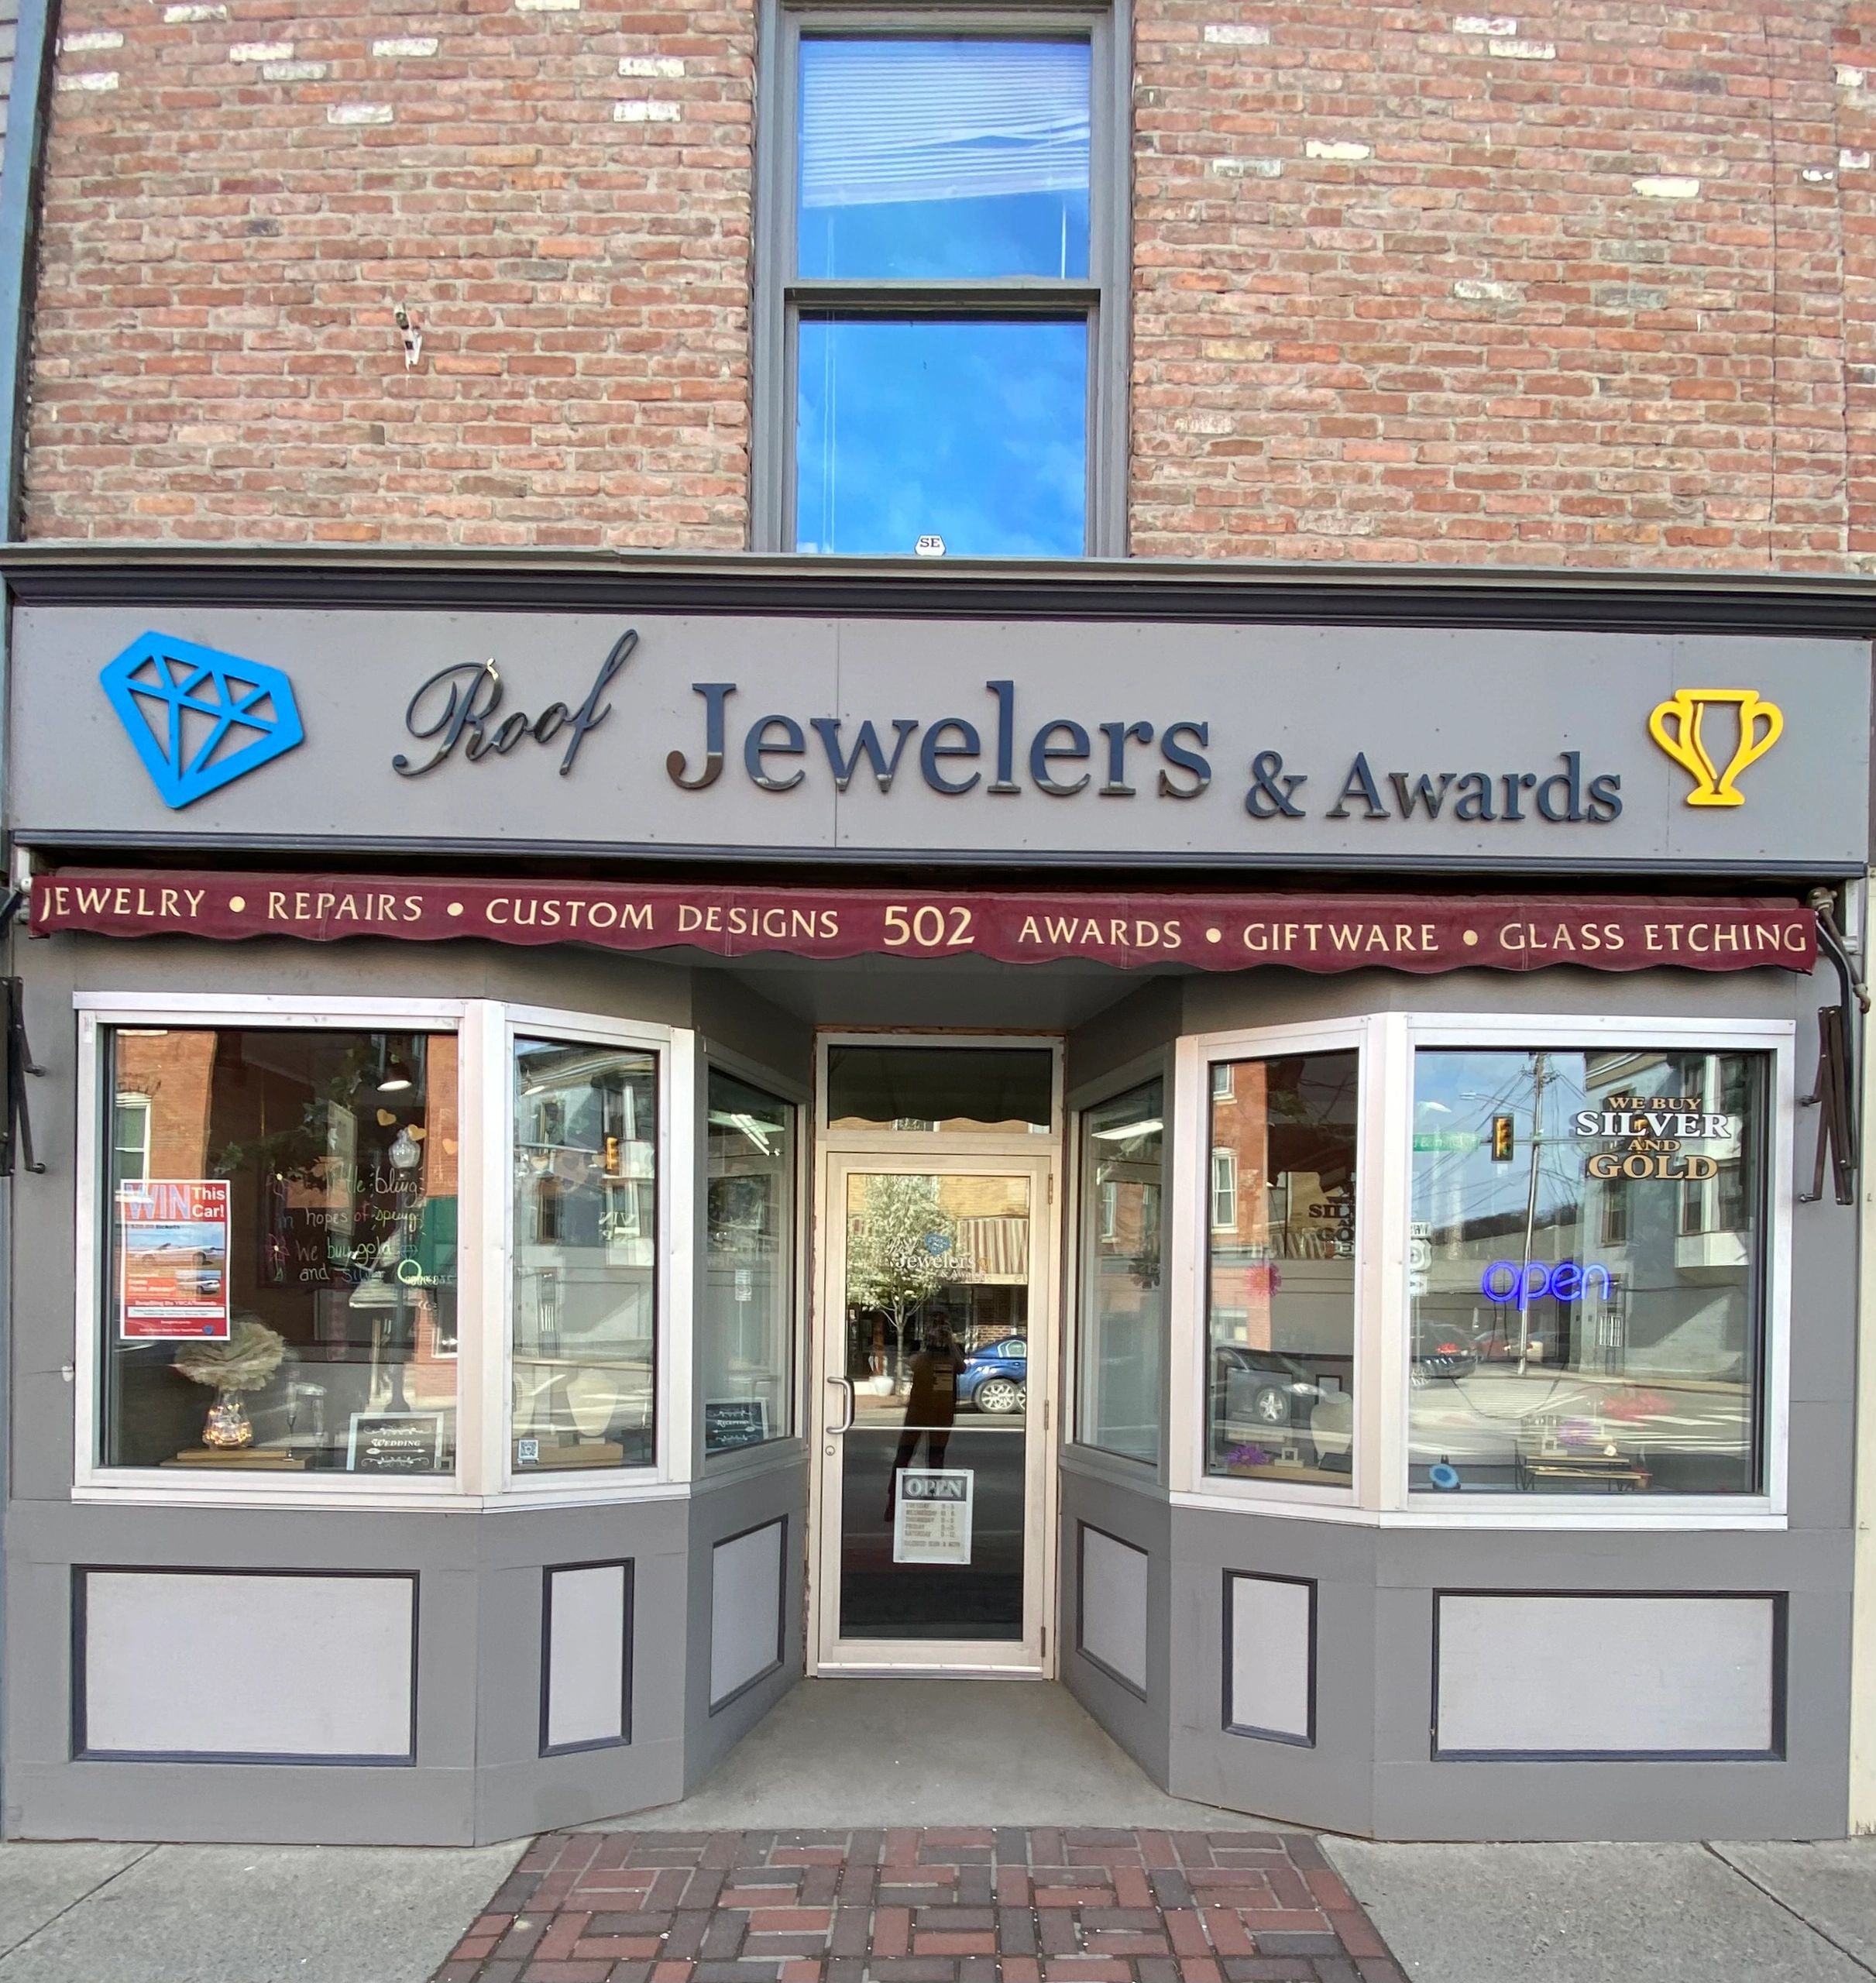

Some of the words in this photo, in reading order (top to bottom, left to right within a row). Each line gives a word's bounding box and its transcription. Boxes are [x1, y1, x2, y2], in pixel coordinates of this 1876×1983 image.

[919, 538, 940, 548] SE
[392, 628, 639, 776] Roof
[666, 679, 1212, 799] Jewelers
[1246, 749, 1307, 819] &
[1325, 751, 1623, 822] Awards
[39, 887, 206, 922] JEWELRY
[267, 890, 423, 922] REPAIRS
[486, 898, 655, 930] CUSTOM
[678, 904, 840, 939] DESIGNS
[883, 906, 976, 947] 502
[1018, 916, 1182, 949] AWARDS
[1243, 923, 1440, 953] GIFTWARE
[1500, 923, 1625, 952] GLASS
[1645, 923, 1806, 953] ETCHING
[1608, 1097, 1645, 1109] WE
[1651, 1098, 1702, 1110] BUY
[1575, 1111, 1731, 1138] SILVER
[1627, 1139, 1681, 1152] AND
[1588, 1153, 1719, 1180] GOLD
[125, 1184, 191, 1220] WIN
[191, 1187, 225, 1201] This
[191, 1204, 225, 1218] Car!
[306, 1208, 348, 1232] hopes
[354, 1202, 371, 1222] of
[357, 1236, 393, 1267] gold
[895, 1253, 975, 1269] Jewelers
[299, 1263, 331, 1281] and
[1483, 1262, 1610, 1311] open
[905, 1478, 964, 1497] OPEN
